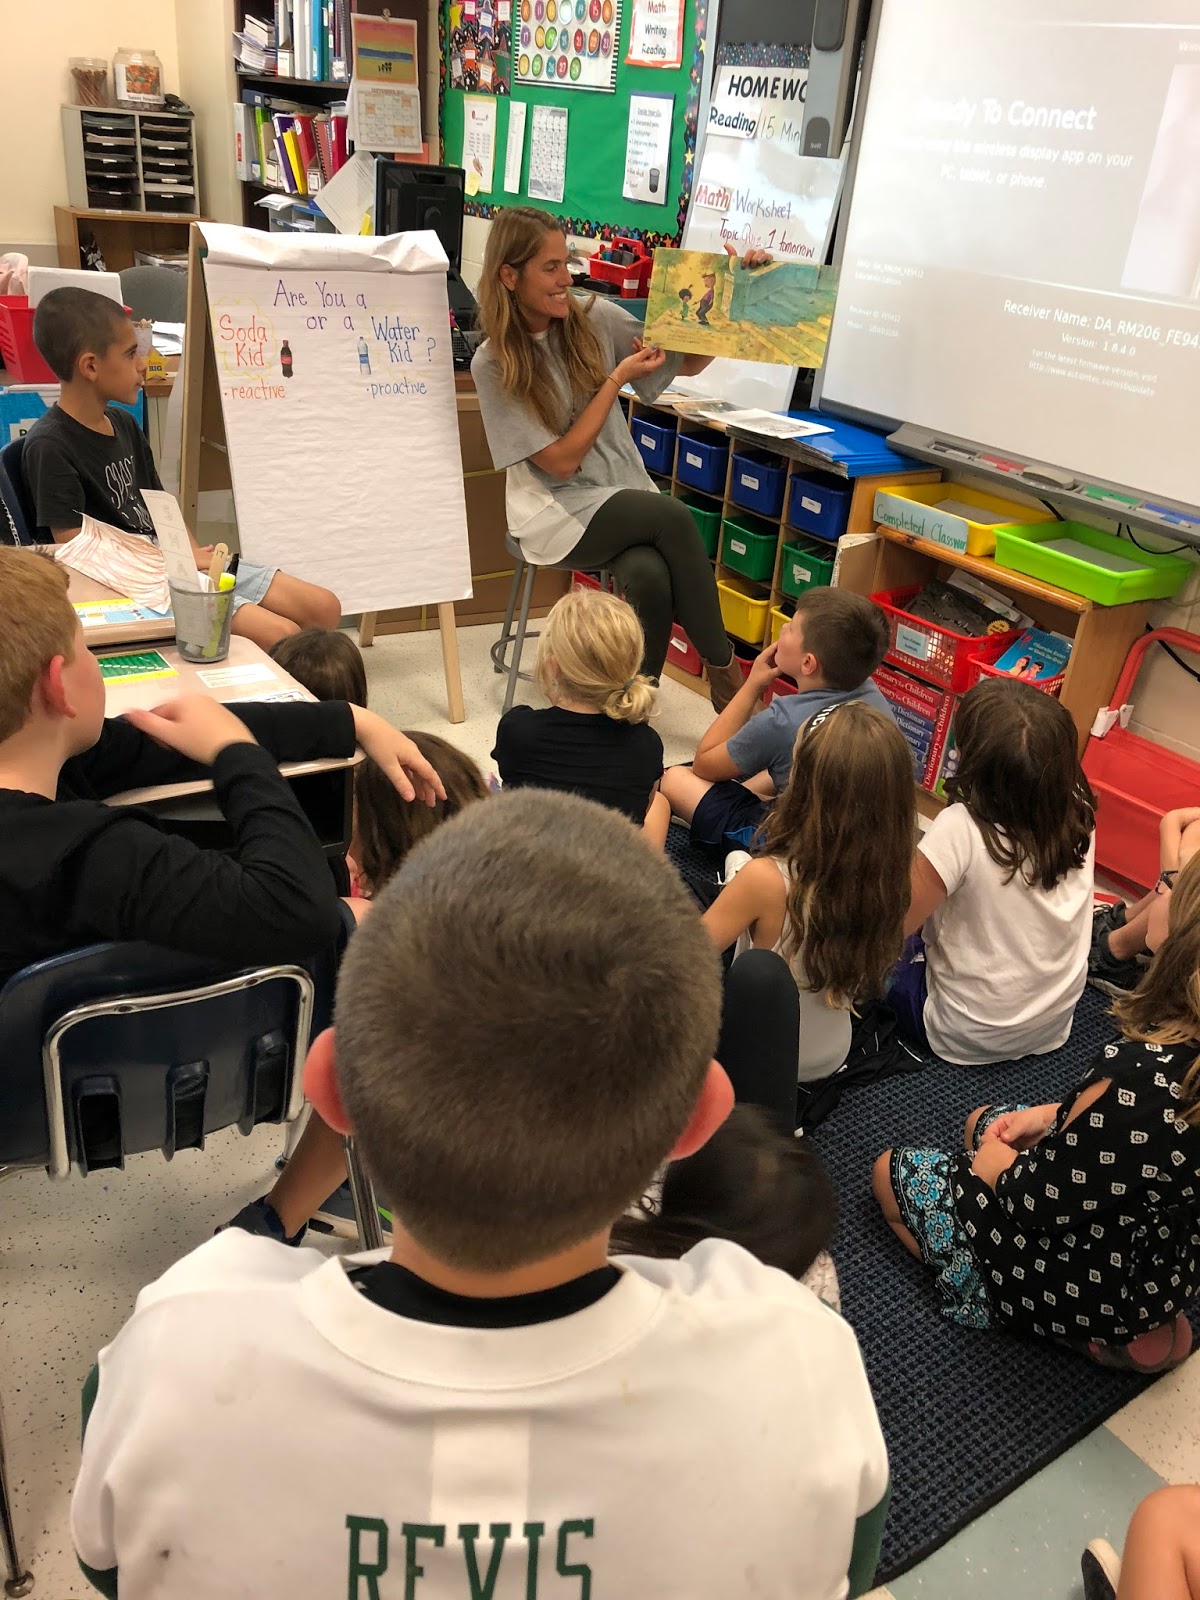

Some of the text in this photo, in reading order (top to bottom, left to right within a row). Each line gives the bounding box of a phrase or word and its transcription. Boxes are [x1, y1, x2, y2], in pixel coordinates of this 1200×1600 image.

[648, 1, 666, 14] Math
[645, 24, 667, 39] Writing
[641, 43, 667, 59] Reading
[709, 106, 756, 136] Reading
[981, 97, 1002, 125] To
[1008, 100, 1097, 131] Connect
[760, 115, 776, 140] 15
[1019, 144, 1059, 163] display
[1061, 150, 1084, 165] app
[1086, 151, 1103, 164] on
[1105, 153, 1134, 168] your
[996, 173, 1009, 184] or
[1010, 172, 1048, 190] phone.
[695, 184, 730, 208] Math
[719, 217, 739, 243] Topic
[764, 228, 777, 249] 1
[778, 230, 815, 258] tomorrow
[274, 279, 367, 309] Are You a
[219, 314, 268, 342] Soda
[306, 314, 354, 331] or a
[371, 315, 422, 341] Water
[1003, 299, 1200, 350] Receiver Name: DA_RM206_FE94
[387, 337, 437, 363] Kid ?
[1062, 332, 1099, 349] Version:
[235, 342, 265, 367] Kid
[231, 379, 286, 400] reactive
[370, 376, 427, 399] proactive
[876, 503, 925, 536] Completed
[904, 682, 934, 704] Children
[897, 705, 926, 727] Dictionary
[901, 695, 931, 717] Children
[897, 716, 924, 738] Dictionary
[925, 740, 941, 785] Dictionary
[937, 695, 950, 733] Children
